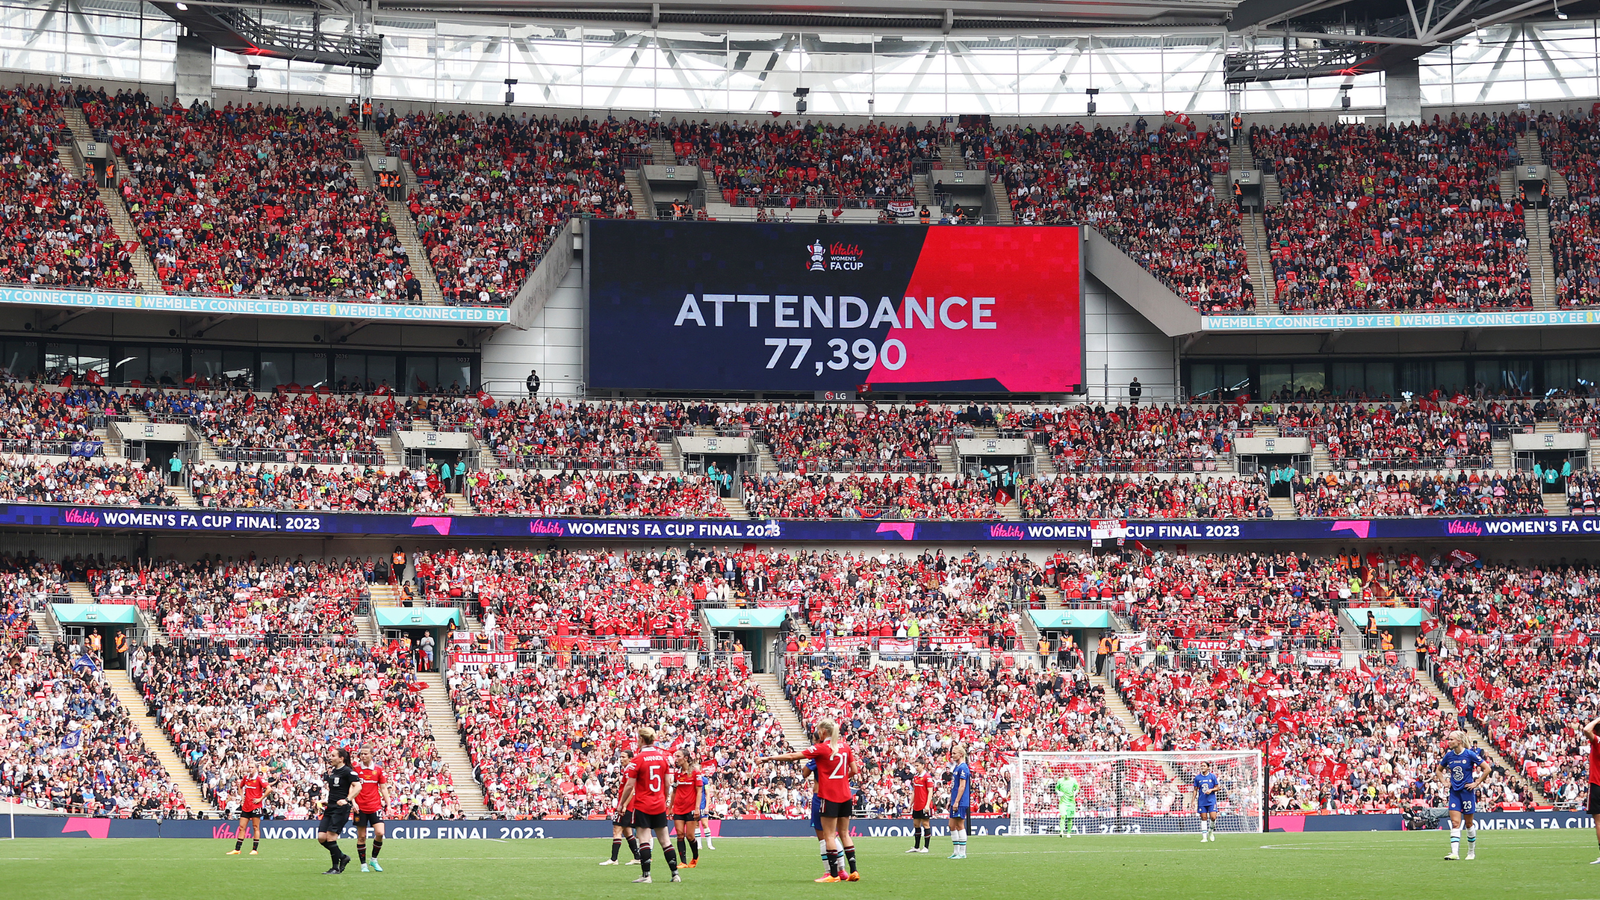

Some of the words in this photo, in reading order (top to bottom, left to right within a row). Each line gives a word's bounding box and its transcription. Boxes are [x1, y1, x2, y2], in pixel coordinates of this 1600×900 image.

[830, 242, 863, 258] Vitality
[830, 261, 843, 270] FA
[844, 261, 863, 270] CUP
[14, 291, 93, 305] CONNECTED
[96, 296, 114, 306] BY
[118, 296, 132, 307] EE
[143, 298, 207, 312] WEMBLEY
[210, 302, 288, 314] CONNECTED
[292, 304, 309, 314] BY
[313, 304, 327, 314] EE
[337, 306, 401, 318] WEMBLEY
[404, 308, 483, 321] CONNECTED
[489, 310, 504, 321] BY
[674, 294, 997, 329] ATTENDANCE
[1209, 317, 1273, 328] WEMBLEY
[1276, 316, 1354, 327] CONNECTED
[1357, 315, 1374, 326] BY
[1377, 315, 1391, 325] EE
[1402, 315, 1465, 326] WEMBLEY
[1467, 313, 1545, 325] CONNECTED
[1550, 313, 1566, 323] BY
[1569, 312, 1583, 323] EE
[765, 338, 906, 375] 77,390
[65, 509, 100, 527] Vitality
[103, 512, 176, 526] WOMEN'S
[180, 513, 198, 527] FA
[201, 513, 232, 529] CUP
[285, 517, 320, 530] 2023
[530, 519, 563, 537] Vitality
[567, 522, 639, 535] WOMEN'S
[644, 523, 661, 536] FA
[664, 524, 695, 536] CUP
[699, 524, 742, 537] FINAL
[1447, 518, 1482, 536] Vitality
[1486, 520, 1556, 533] WOMEN'S
[1562, 520, 1579, 533] FA
[990, 521, 1024, 540] Vitality
[1028, 525, 1091, 538] WOMEN'
[1125, 524, 1154, 538] CUP
[1158, 524, 1202, 538] FINAL
[1206, 524, 1240, 538] 2023
[459, 654, 492, 662] CLAYDON
[829, 752, 848, 779] 21
[649, 765, 662, 792] 5
[1463, 801, 1472, 810] 23
[868, 826, 957, 837] WOMN'
[1540, 818, 1560, 829] FA
[263, 827, 358, 839] WOM'S
[392, 827, 431, 839] CUP
[500, 827, 545, 839] 2023
